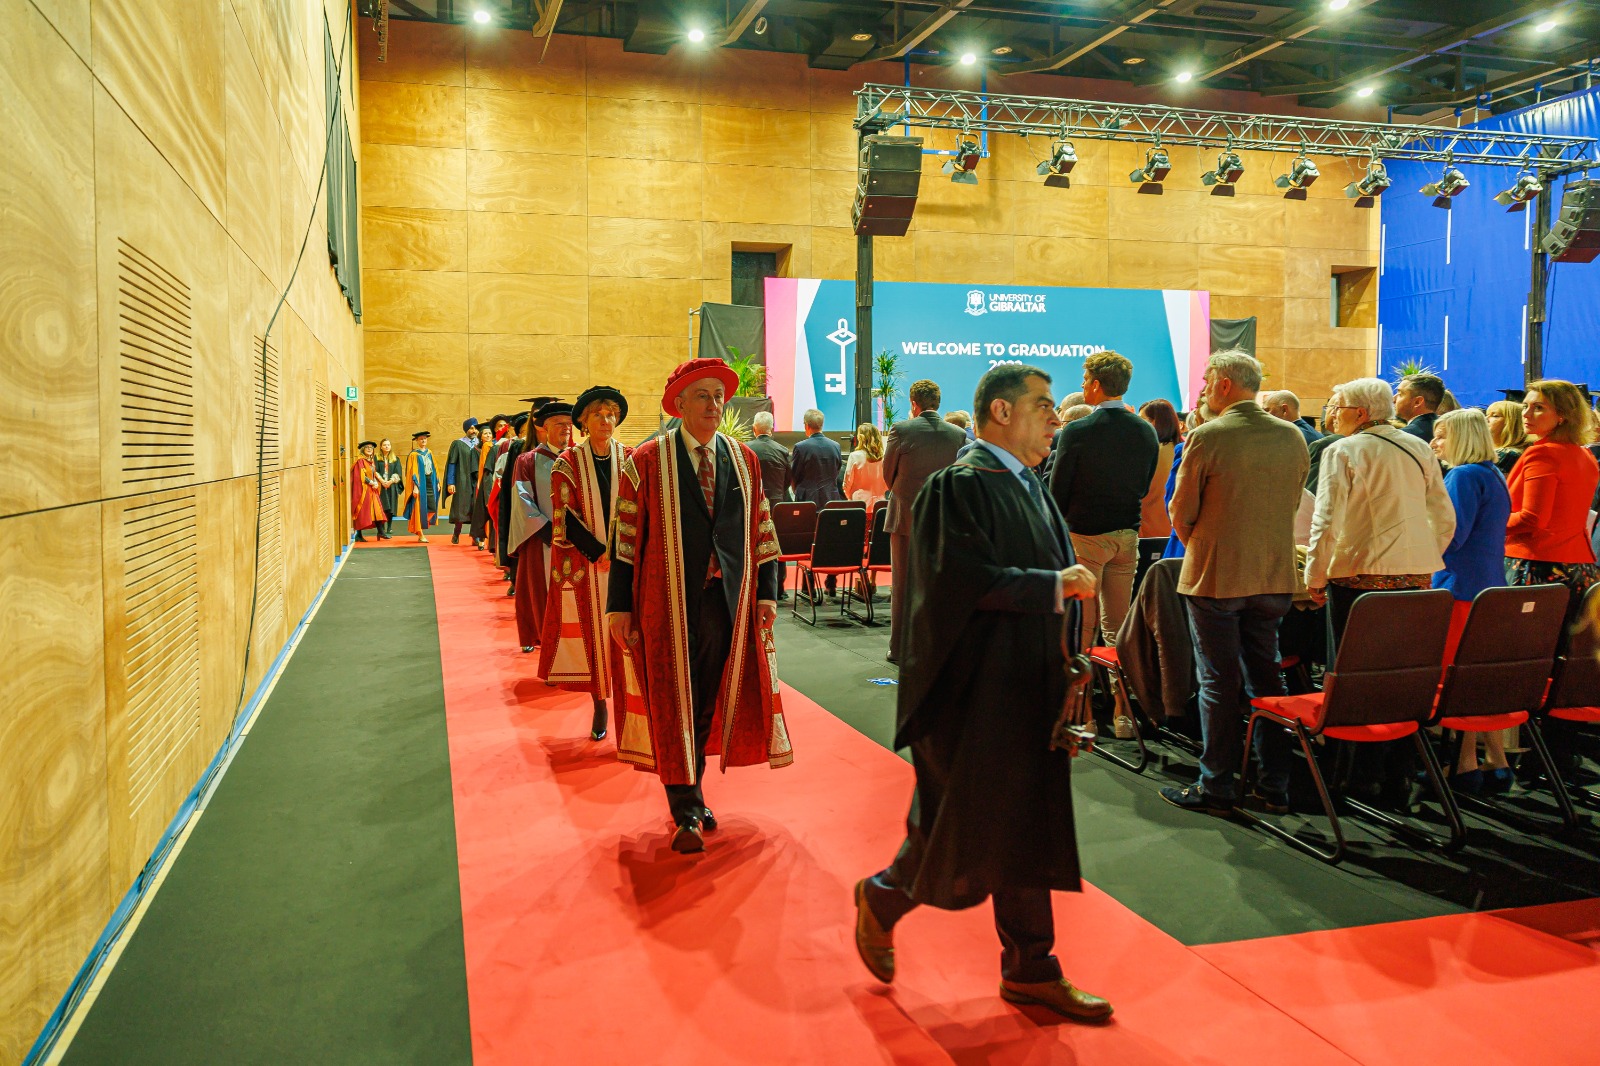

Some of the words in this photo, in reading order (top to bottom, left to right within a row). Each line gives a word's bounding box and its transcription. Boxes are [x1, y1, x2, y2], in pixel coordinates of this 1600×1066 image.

[989, 293, 1033, 302] UNIVERSITY
[989, 301, 1046, 312] GIBRALTAR
[901, 341, 981, 356] WELCOME
[983, 342, 1005, 357] TO
[1008, 343, 1105, 357] GRADUATION
